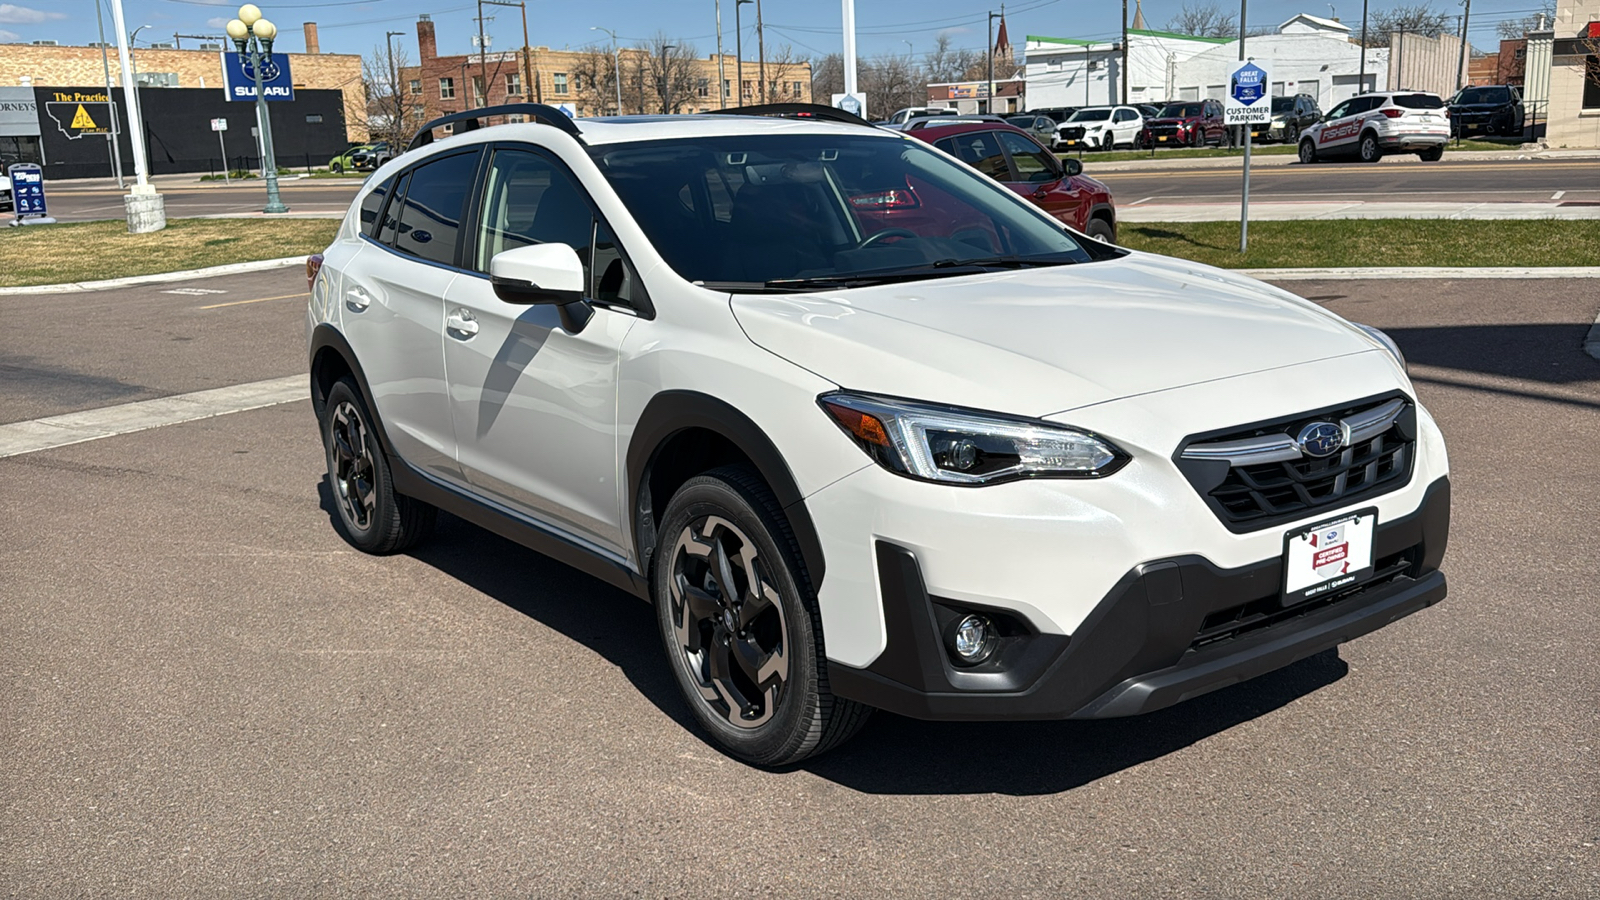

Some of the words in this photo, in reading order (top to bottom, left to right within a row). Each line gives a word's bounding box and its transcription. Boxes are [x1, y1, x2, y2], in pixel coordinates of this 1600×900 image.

[234, 86, 290, 96] SUARU
[53, 92, 73, 102] The
[1226, 107, 1269, 115] CUSTOMER
[1230, 114, 1265, 122] PARKING
[1318, 546, 1344, 559] CERTIFIED
[1315, 551, 1346, 566] PRE-OWNED
